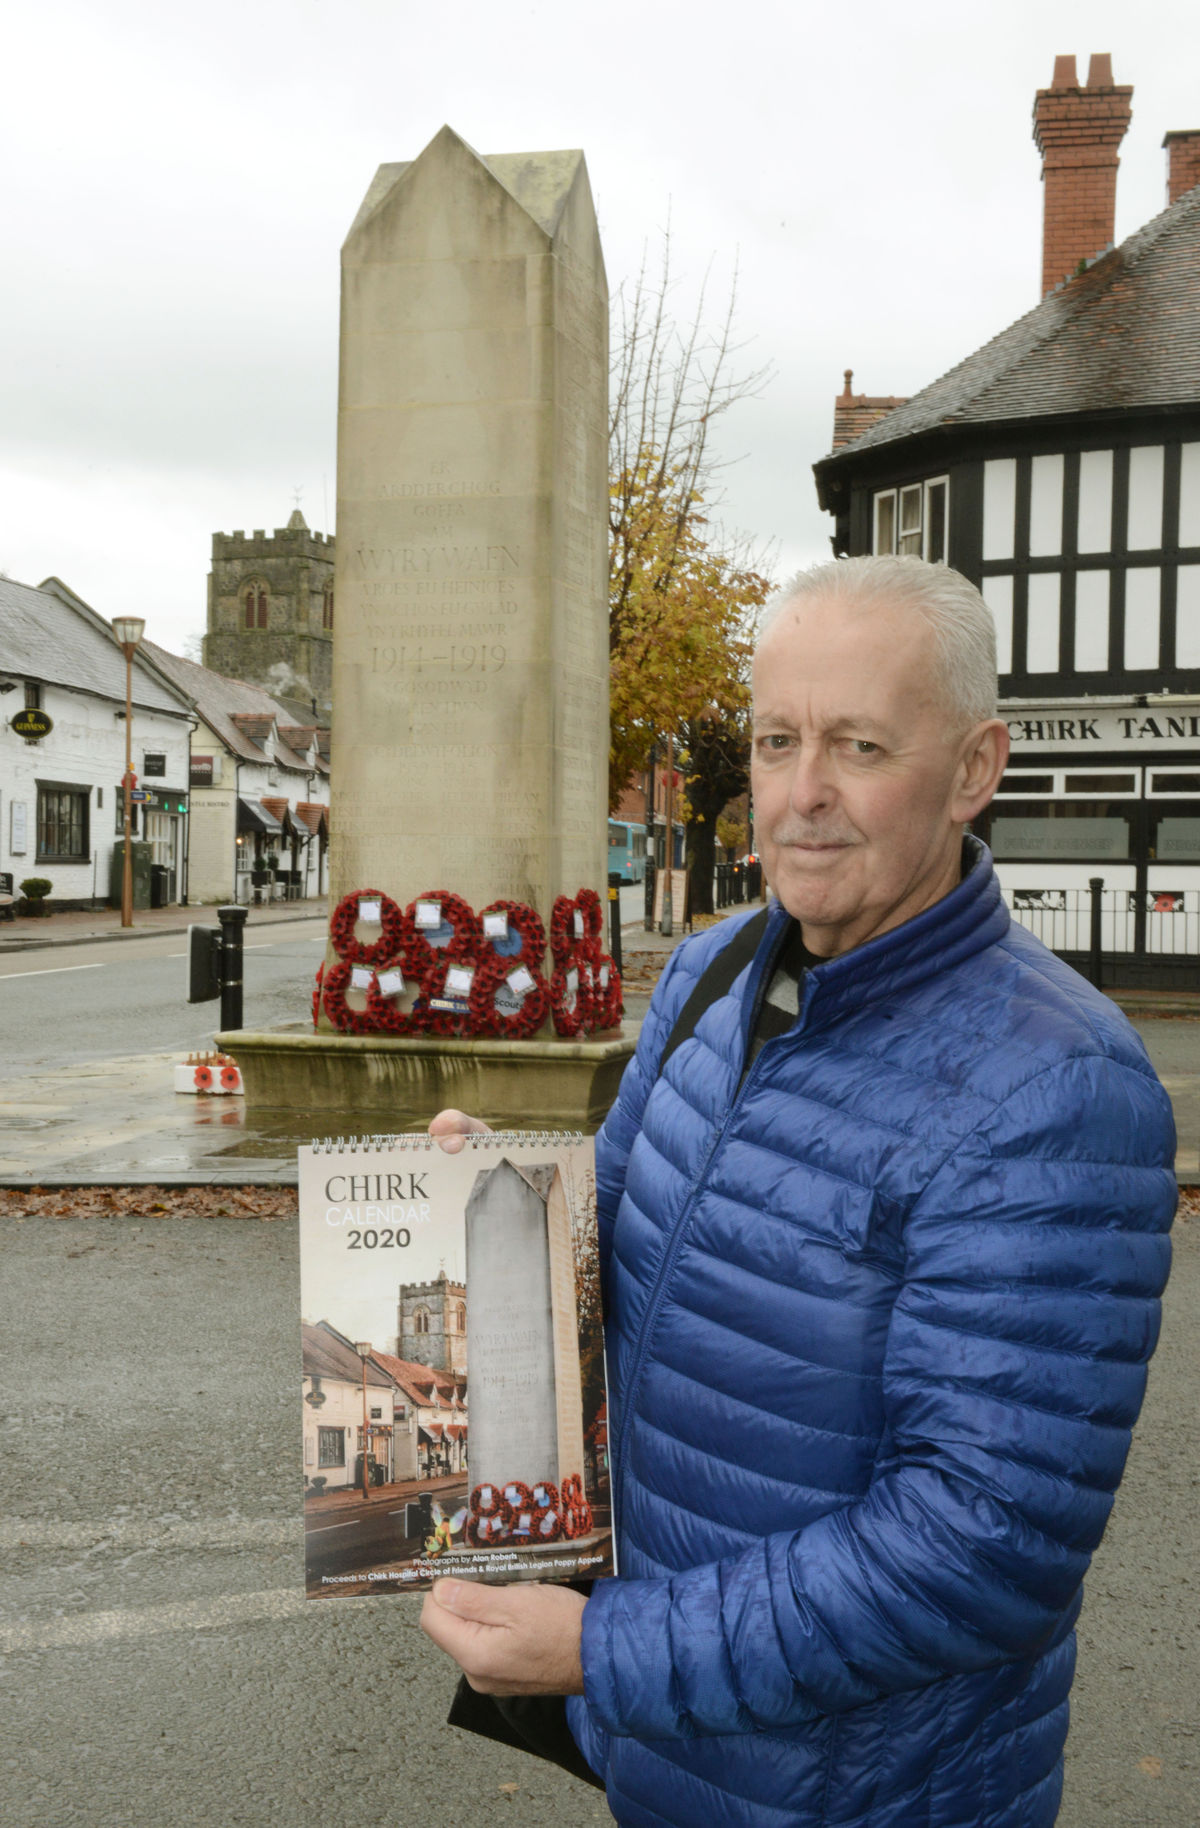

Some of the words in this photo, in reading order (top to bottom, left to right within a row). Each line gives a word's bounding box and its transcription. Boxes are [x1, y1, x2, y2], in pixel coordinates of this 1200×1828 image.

[1007, 718, 1102, 741] CHIRK
[325, 1172, 430, 1203] CHIRK
[325, 1203, 431, 1227] CALENDAR
[346, 1227, 411, 1250] 2020
[321, 1574, 357, 1584] Proceeds
[367, 1571, 387, 1580] Chirk
[389, 1569, 418, 1581] Hospital
[419, 1567, 441, 1577] Circle
[442, 1566, 451, 1575] of
[452, 1564, 477, 1574] Friends
[478, 1564, 485, 1572] &
[486, 1563, 506, 1573] Royal
[529, 1560, 553, 1570] Legion
[554, 1558, 576, 1568] Poppy
[578, 1554, 603, 1566] Appeal
[413, 1557, 458, 1567] Photographs
[459, 1555, 470, 1564] by
[472, 1552, 489, 1562] Alan
[491, 1551, 517, 1561] Roberts
